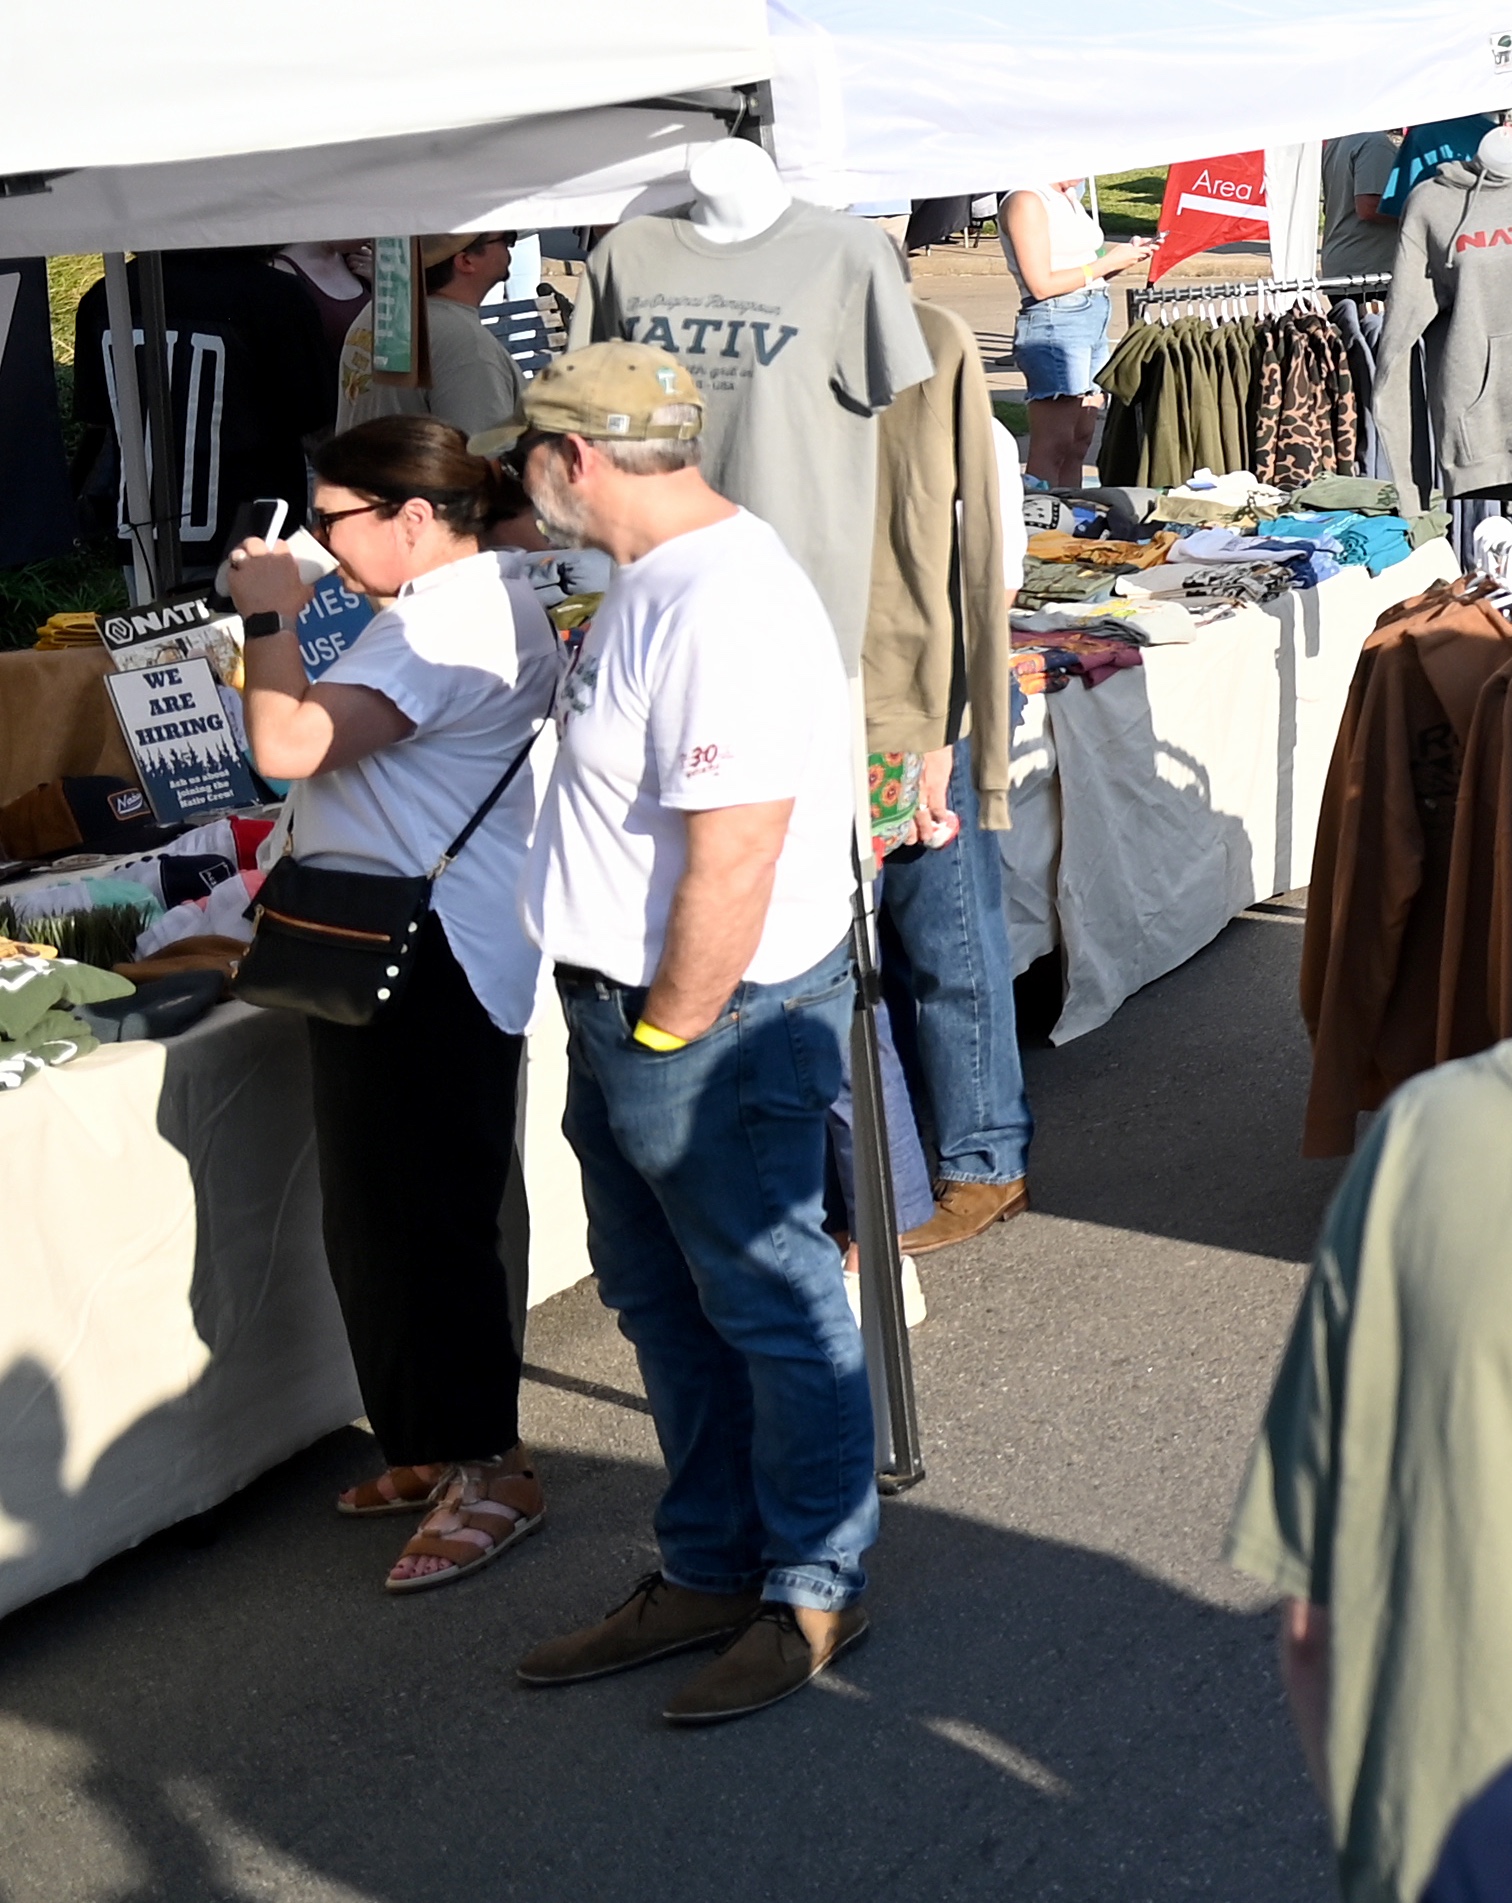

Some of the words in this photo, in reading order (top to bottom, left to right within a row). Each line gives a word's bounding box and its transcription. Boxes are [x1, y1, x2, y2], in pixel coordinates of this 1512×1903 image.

[1191, 169, 1252, 200] Area
[131, 597, 209, 635] NATI
[299, 631, 346, 666] USE
[143, 667, 182, 689] WE
[149, 692, 196, 716] ARE
[135, 714, 223, 746] HIRING
